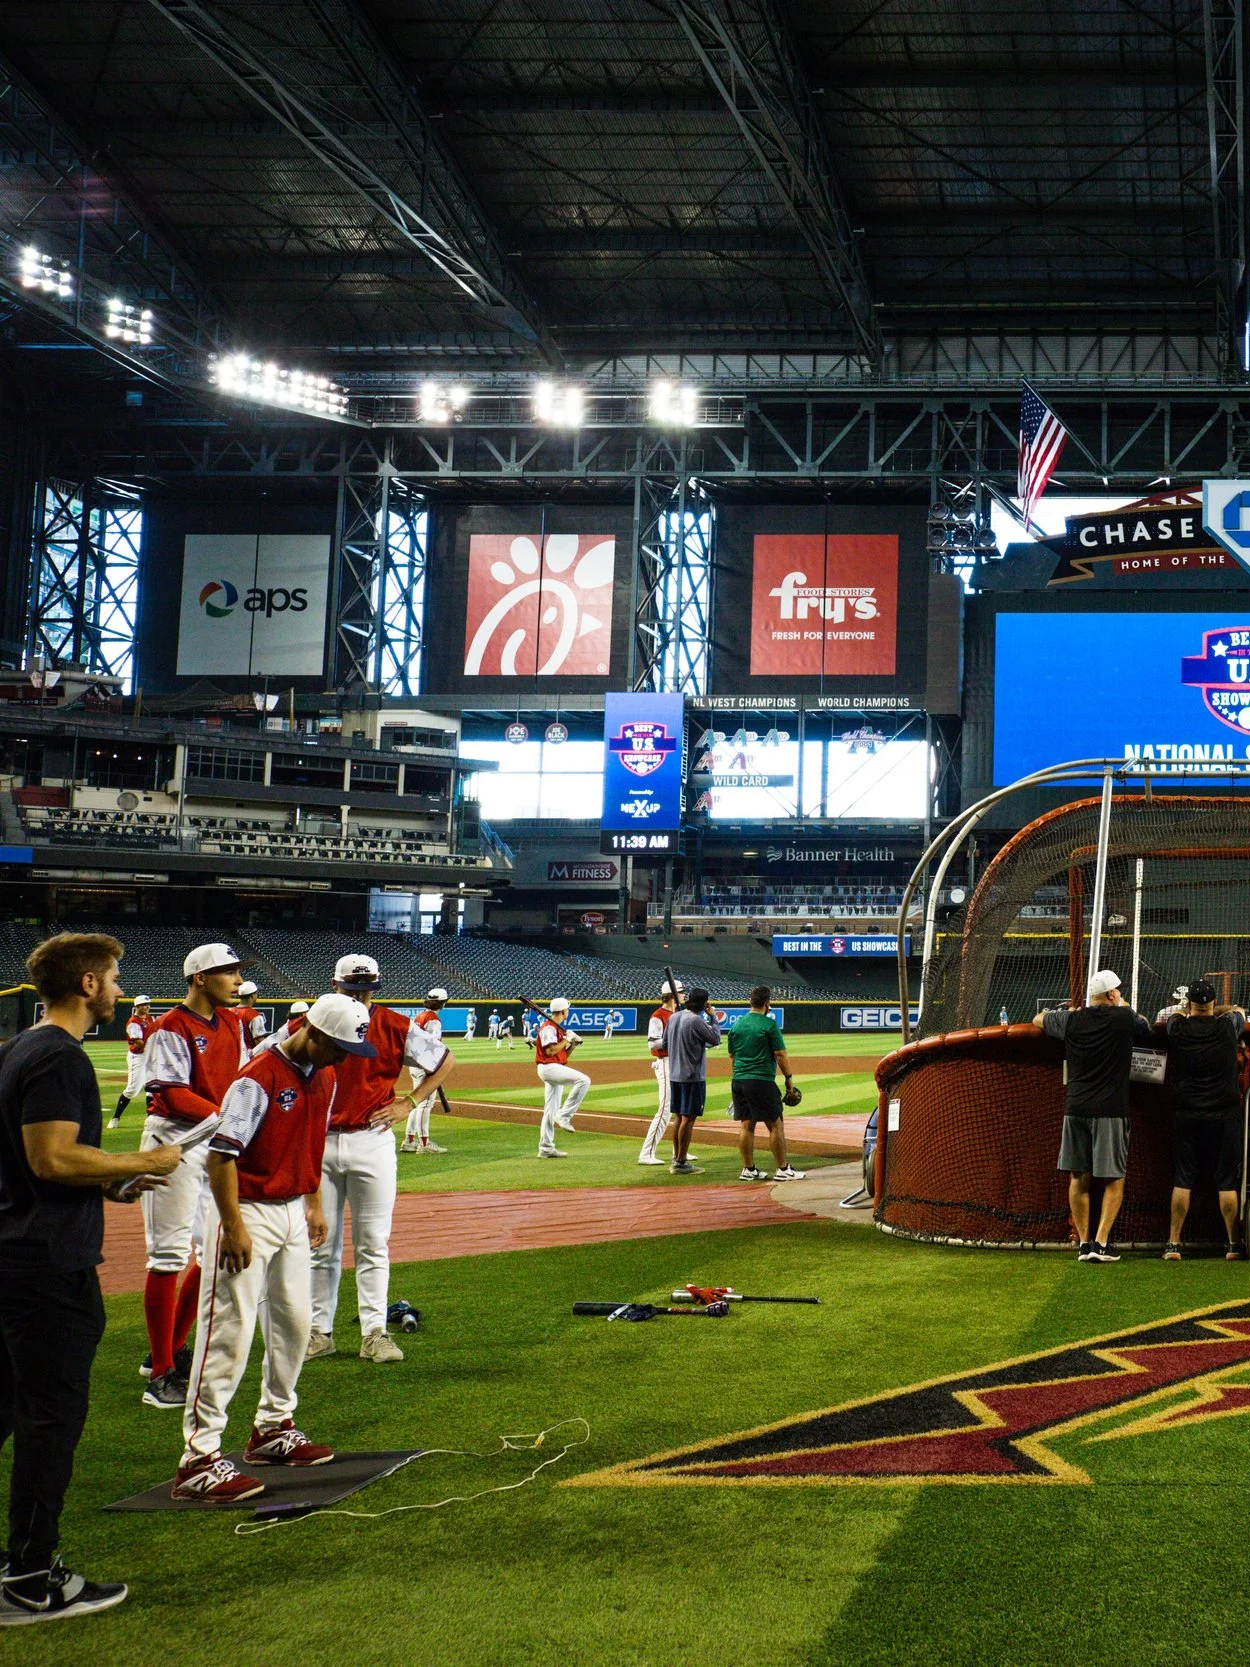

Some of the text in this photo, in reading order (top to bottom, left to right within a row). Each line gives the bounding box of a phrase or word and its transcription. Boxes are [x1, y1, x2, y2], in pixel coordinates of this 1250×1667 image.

[1079, 517, 1195, 547] CHASE
[1121, 558, 1160, 570] HOME
[1171, 556, 1188, 565] OF
[1199, 555, 1225, 565] THE
[768, 571, 877, 624] fry's
[797, 588, 871, 596] FOOD STORES
[243, 588, 308, 618] aps
[772, 632, 875, 640] FRESH FOR EVERYONE
[692, 697, 796, 708] NL WEST CHAMPIONS
[818, 697, 910, 708] WORLD CHAMPIONS
[1124, 744, 1240, 772] NATIONAL
[713, 776, 769, 786] WILD CARD
[612, 836, 669, 848] 11:39 AM
[785, 848, 895, 862] Banner Health
[572, 869, 611, 878] FITNESS
[584, 915, 602, 923] Tyson
[783, 942, 800, 951] BEST
[800, 942, 807, 951] IN
[810, 942, 822, 951] THE
[851, 942, 861, 951] US
[564, 1013, 605, 1026] ASE
